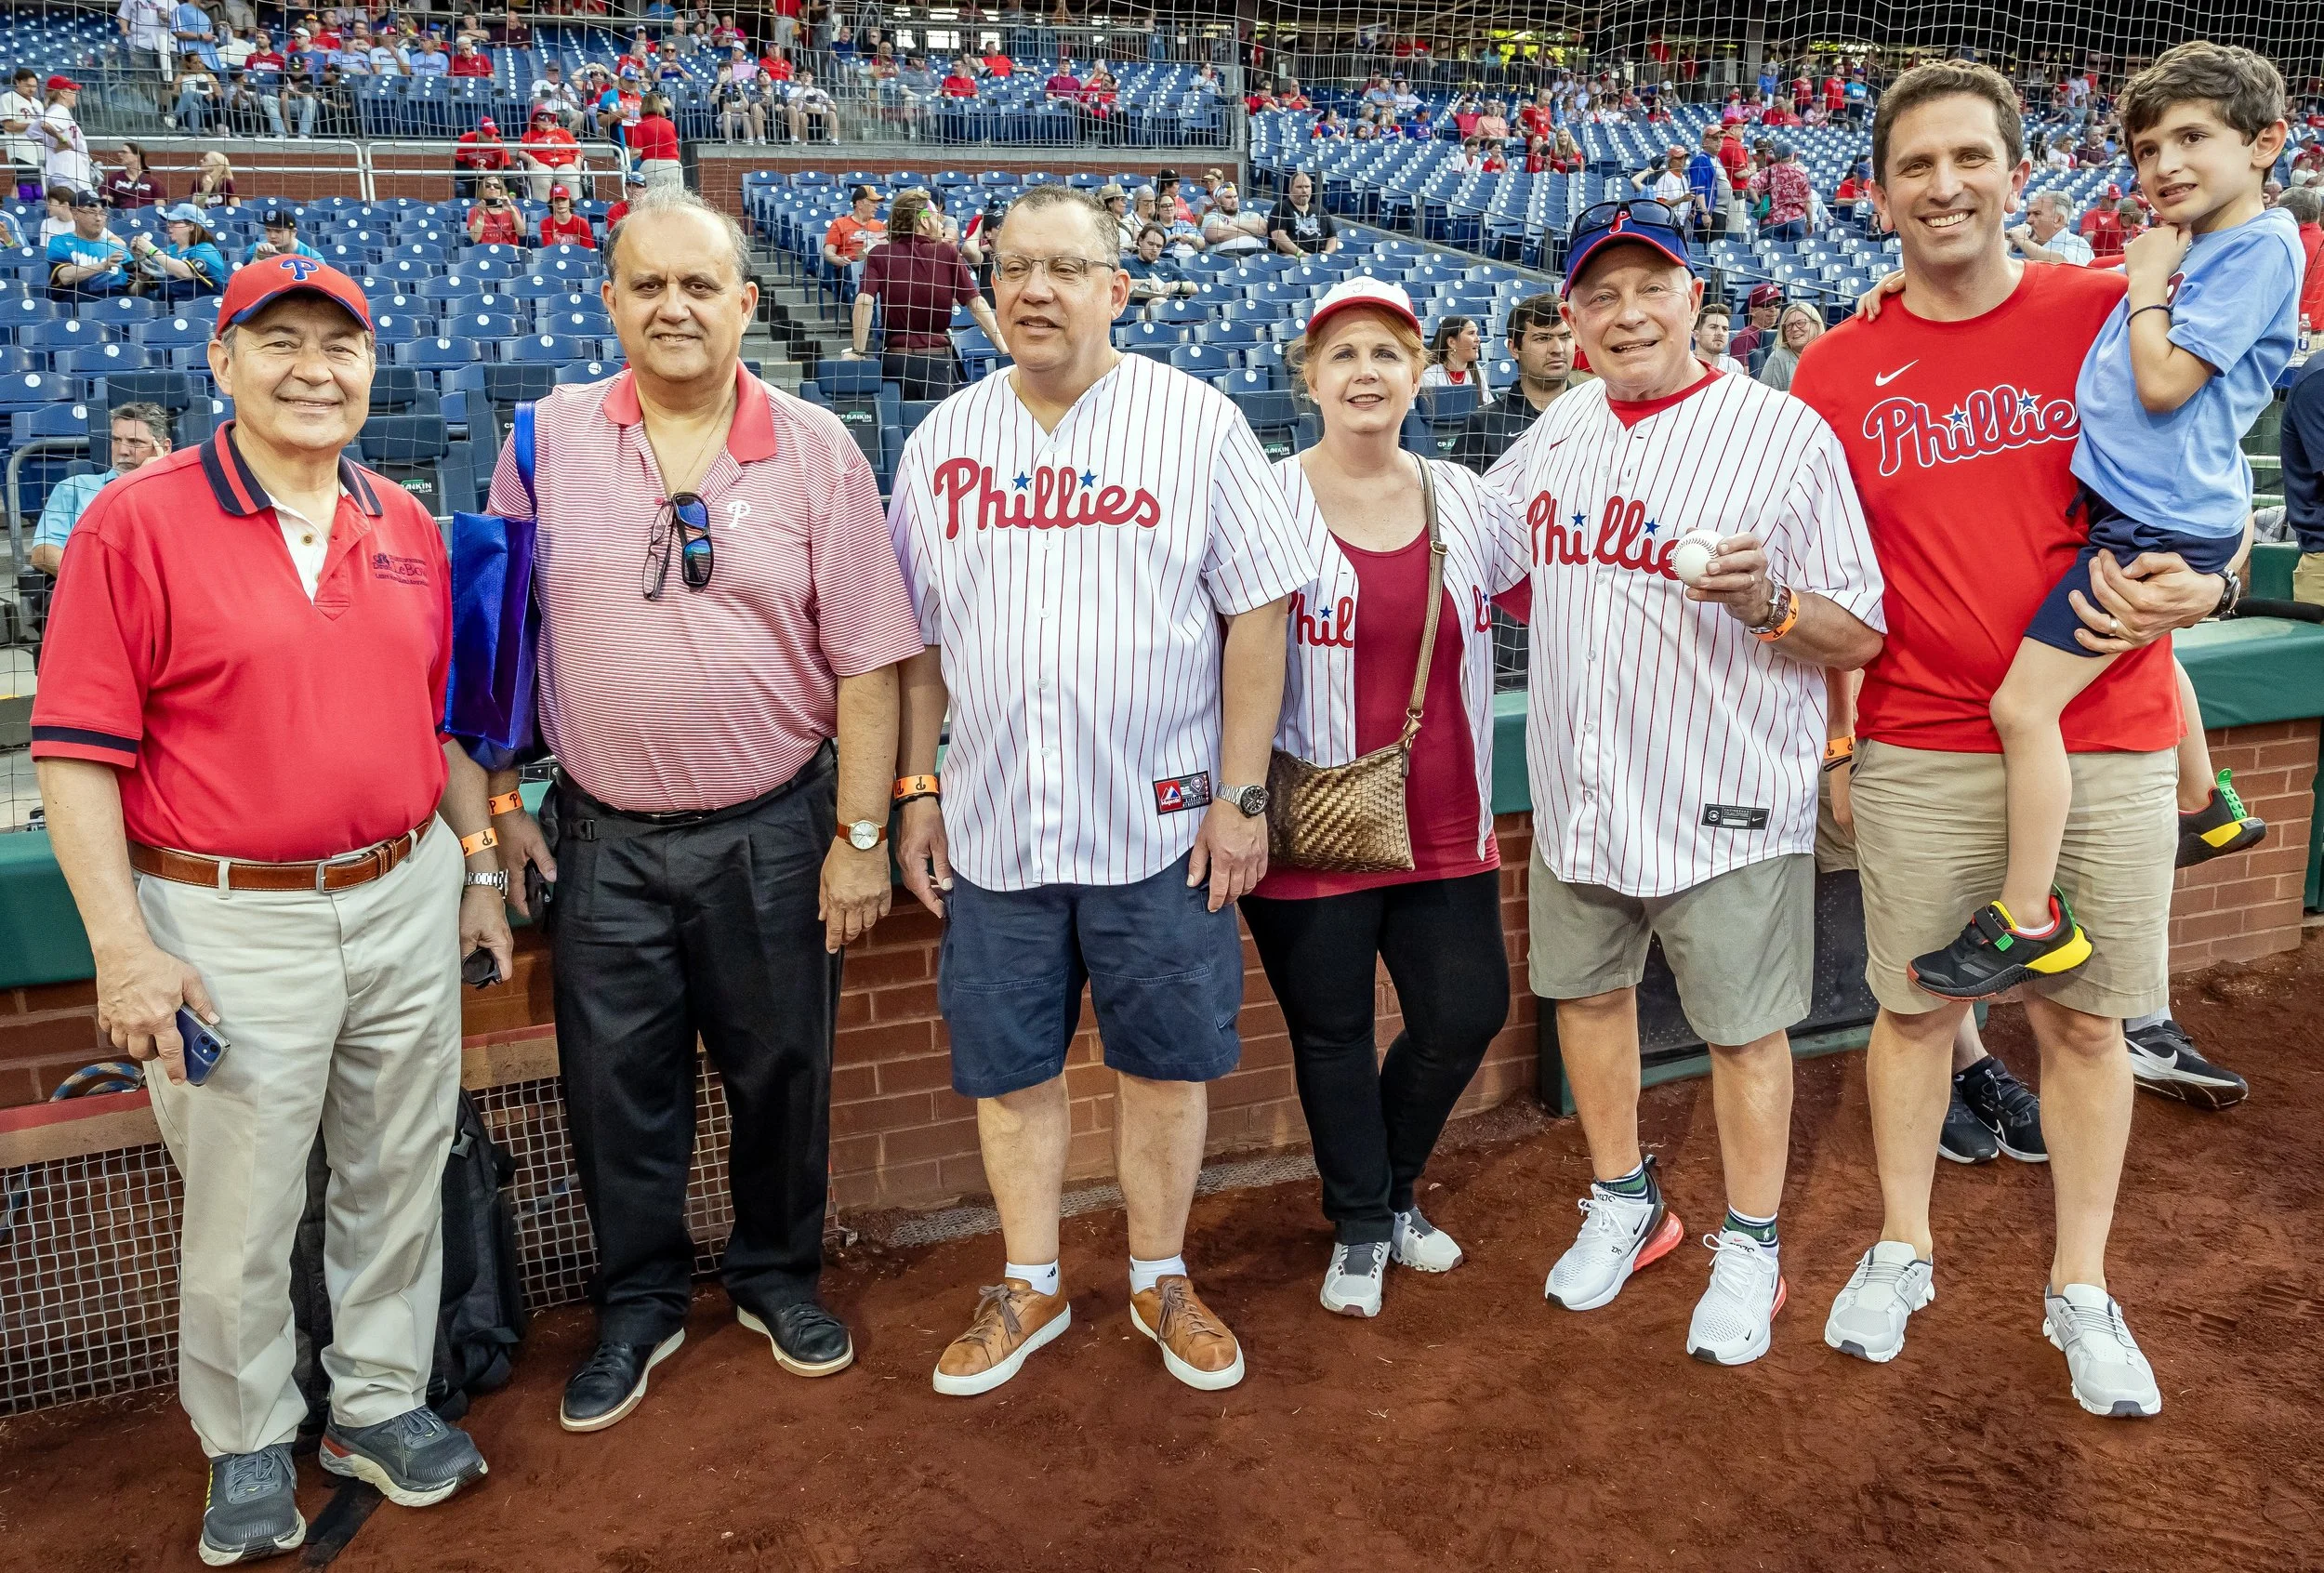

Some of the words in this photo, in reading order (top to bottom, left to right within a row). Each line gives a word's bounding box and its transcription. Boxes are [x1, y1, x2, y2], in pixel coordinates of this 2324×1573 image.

[279, 258, 319, 281] P
[1863, 384, 2081, 477] Phillie
[932, 456, 1162, 542] Phillies
[725, 500, 751, 528] P
[1526, 489, 1682, 581] Phillie
[1287, 590, 1354, 648] hil
[916, 776, 926, 790] P
[508, 793, 518, 807] P
[482, 831, 494, 846] P
